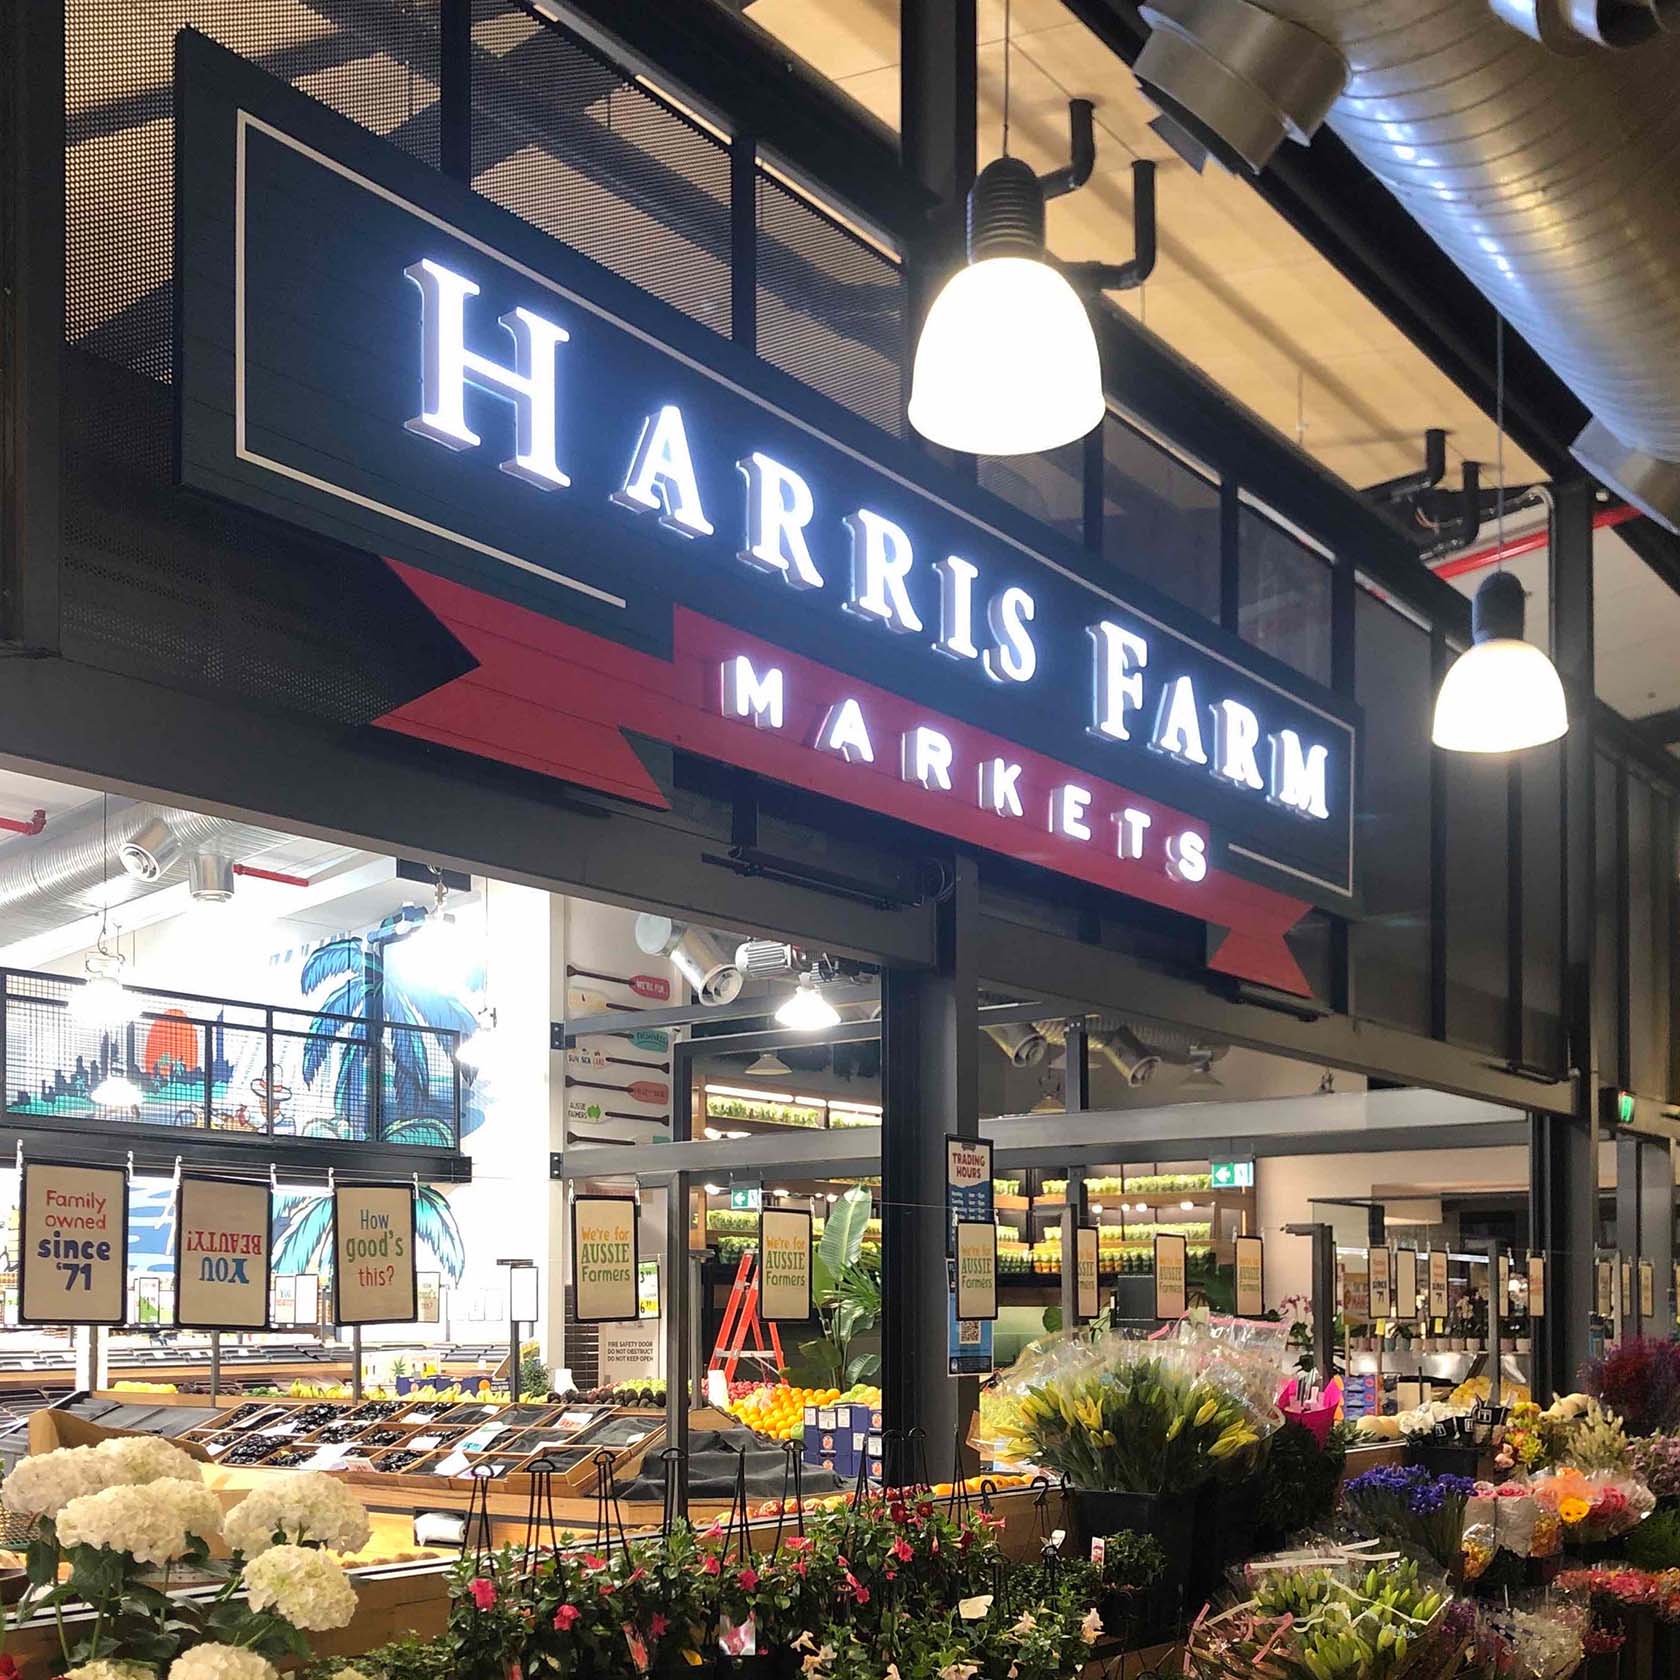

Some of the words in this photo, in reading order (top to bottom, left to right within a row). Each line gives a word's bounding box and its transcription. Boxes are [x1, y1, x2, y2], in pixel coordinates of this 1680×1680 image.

[403, 257, 1037, 684] HARRIS
[1085, 619, 1330, 820] FARM
[720, 655, 1208, 882] MARKETS
[952, 1153, 985, 1167] TRADING
[956, 1166, 981, 1178] HOURS
[46, 1190, 106, 1211] Family
[45, 1213, 106, 1230] owned
[360, 1208, 389, 1230] How
[581, 1227, 610, 1241] We're
[614, 1226, 630, 1241] for
[766, 1237, 790, 1249] We're
[793, 1236, 806, 1250] for
[37, 1231, 111, 1262] since
[187, 1231, 262, 1256] BEAUTY!
[346, 1231, 404, 1263] good's
[581, 1243, 630, 1264] AUSSIE
[766, 1252, 805, 1270] AUSSIE
[199, 1256, 250, 1284] YOU
[581, 1266, 631, 1283] Farmers
[961, 1258, 992, 1274] AUSSIE
[357, 1265, 394, 1288] this?
[766, 1271, 806, 1287] Farmers
[961, 1275, 993, 1289] Farmers
